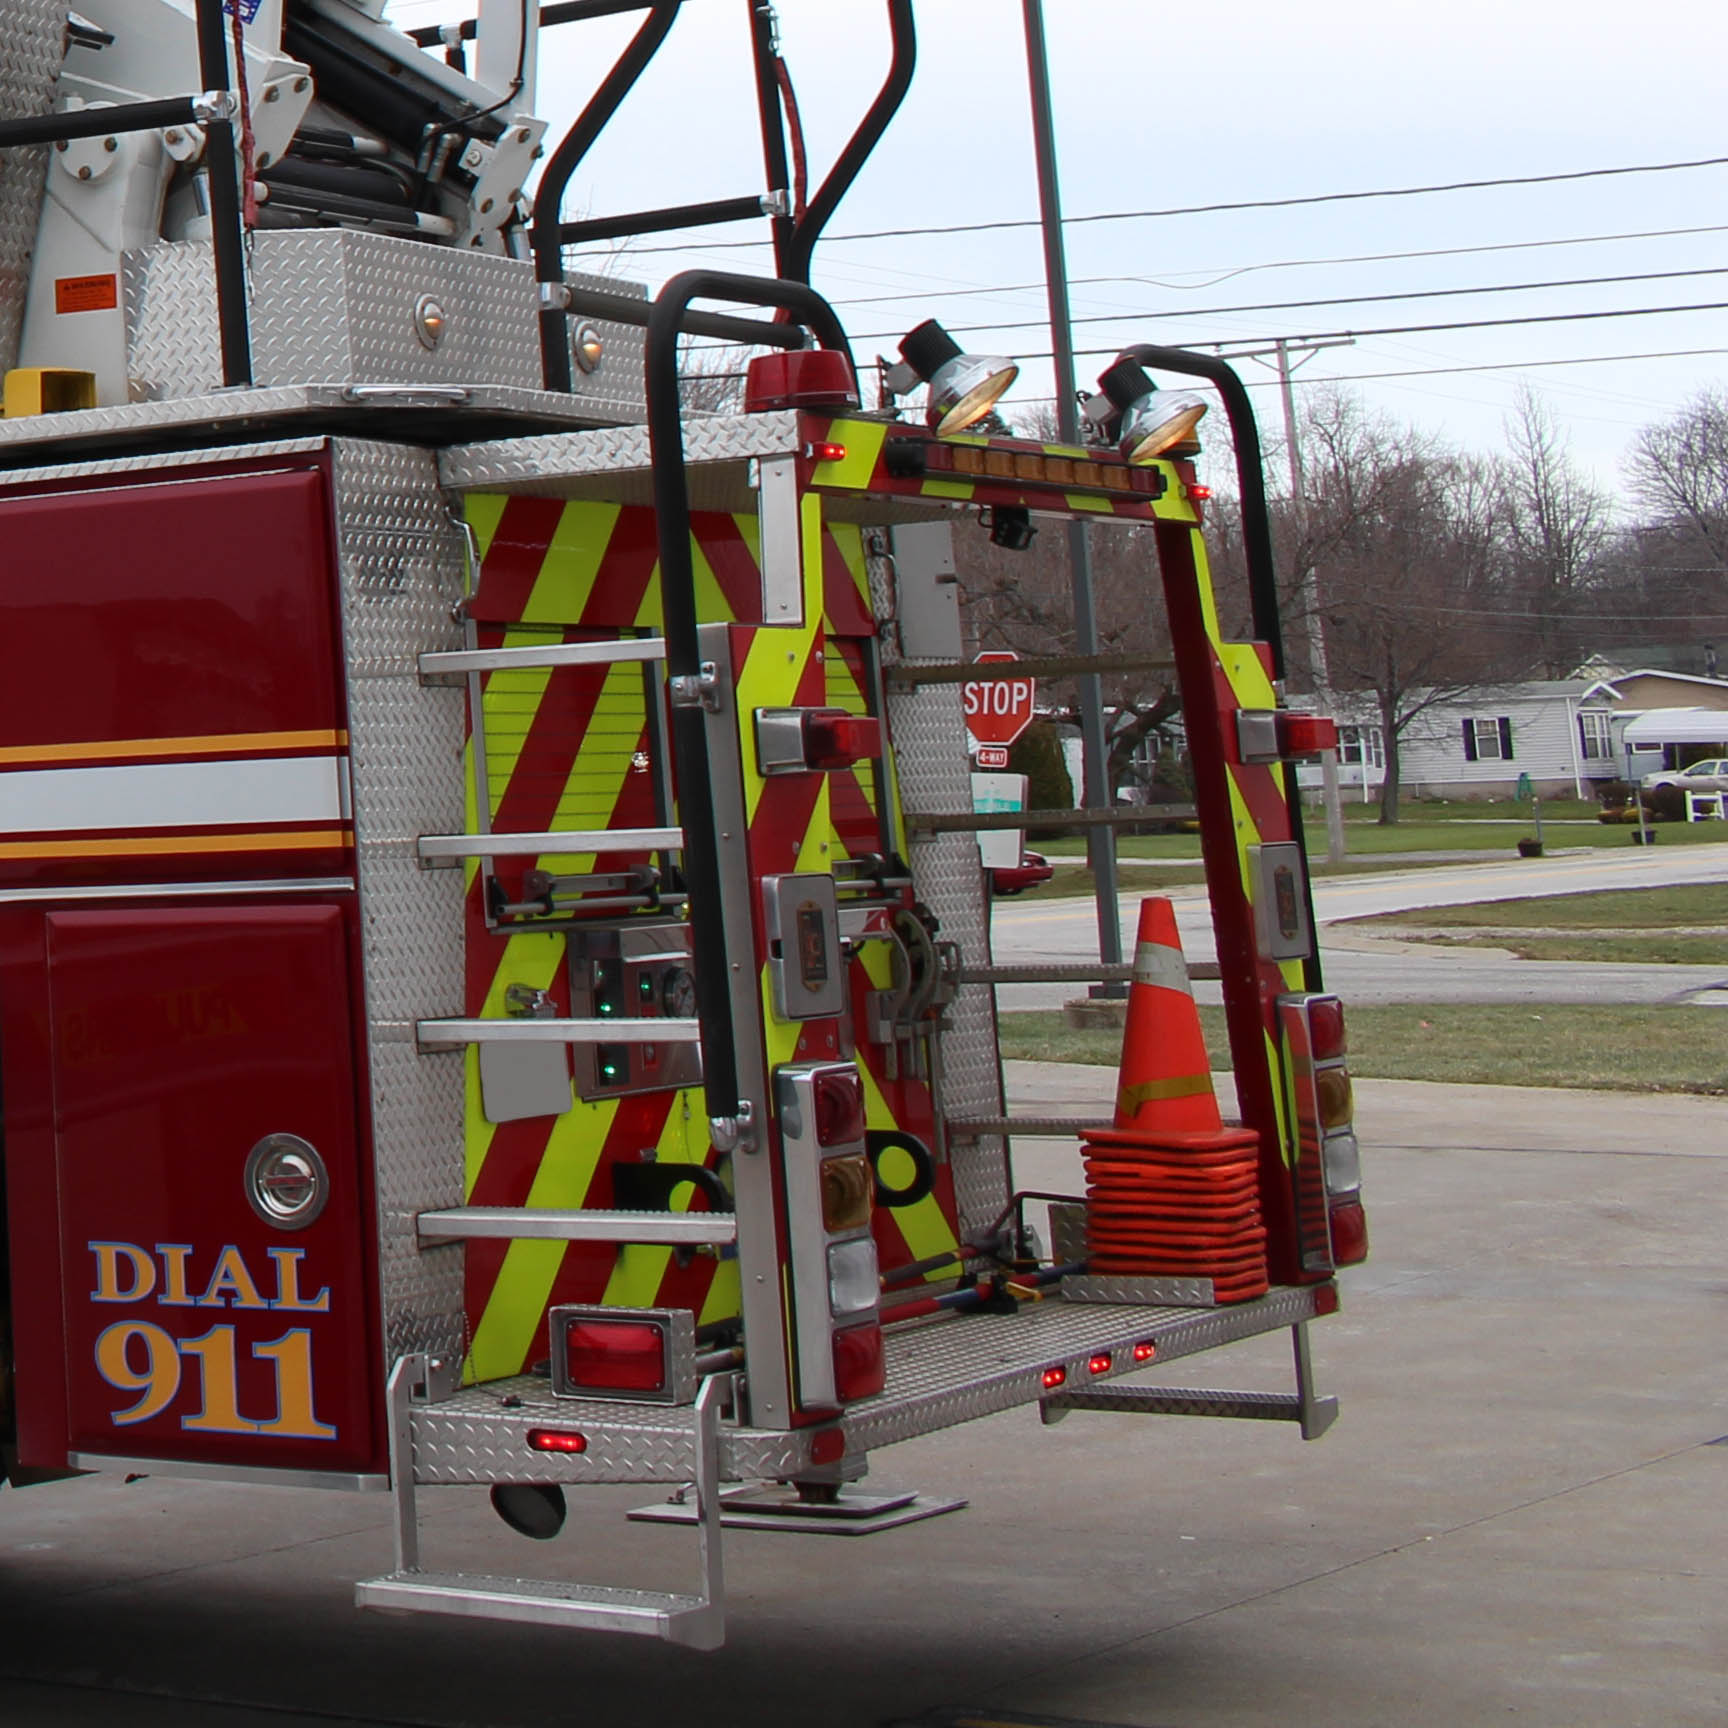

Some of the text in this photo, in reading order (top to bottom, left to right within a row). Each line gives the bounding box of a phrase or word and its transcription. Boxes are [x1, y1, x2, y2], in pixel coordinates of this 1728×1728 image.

[964, 681, 1028, 715] STOP
[980, 752, 1005, 763] 4-WAY
[87, 1241, 331, 1312] DIAL
[95, 1320, 337, 1440] 911
